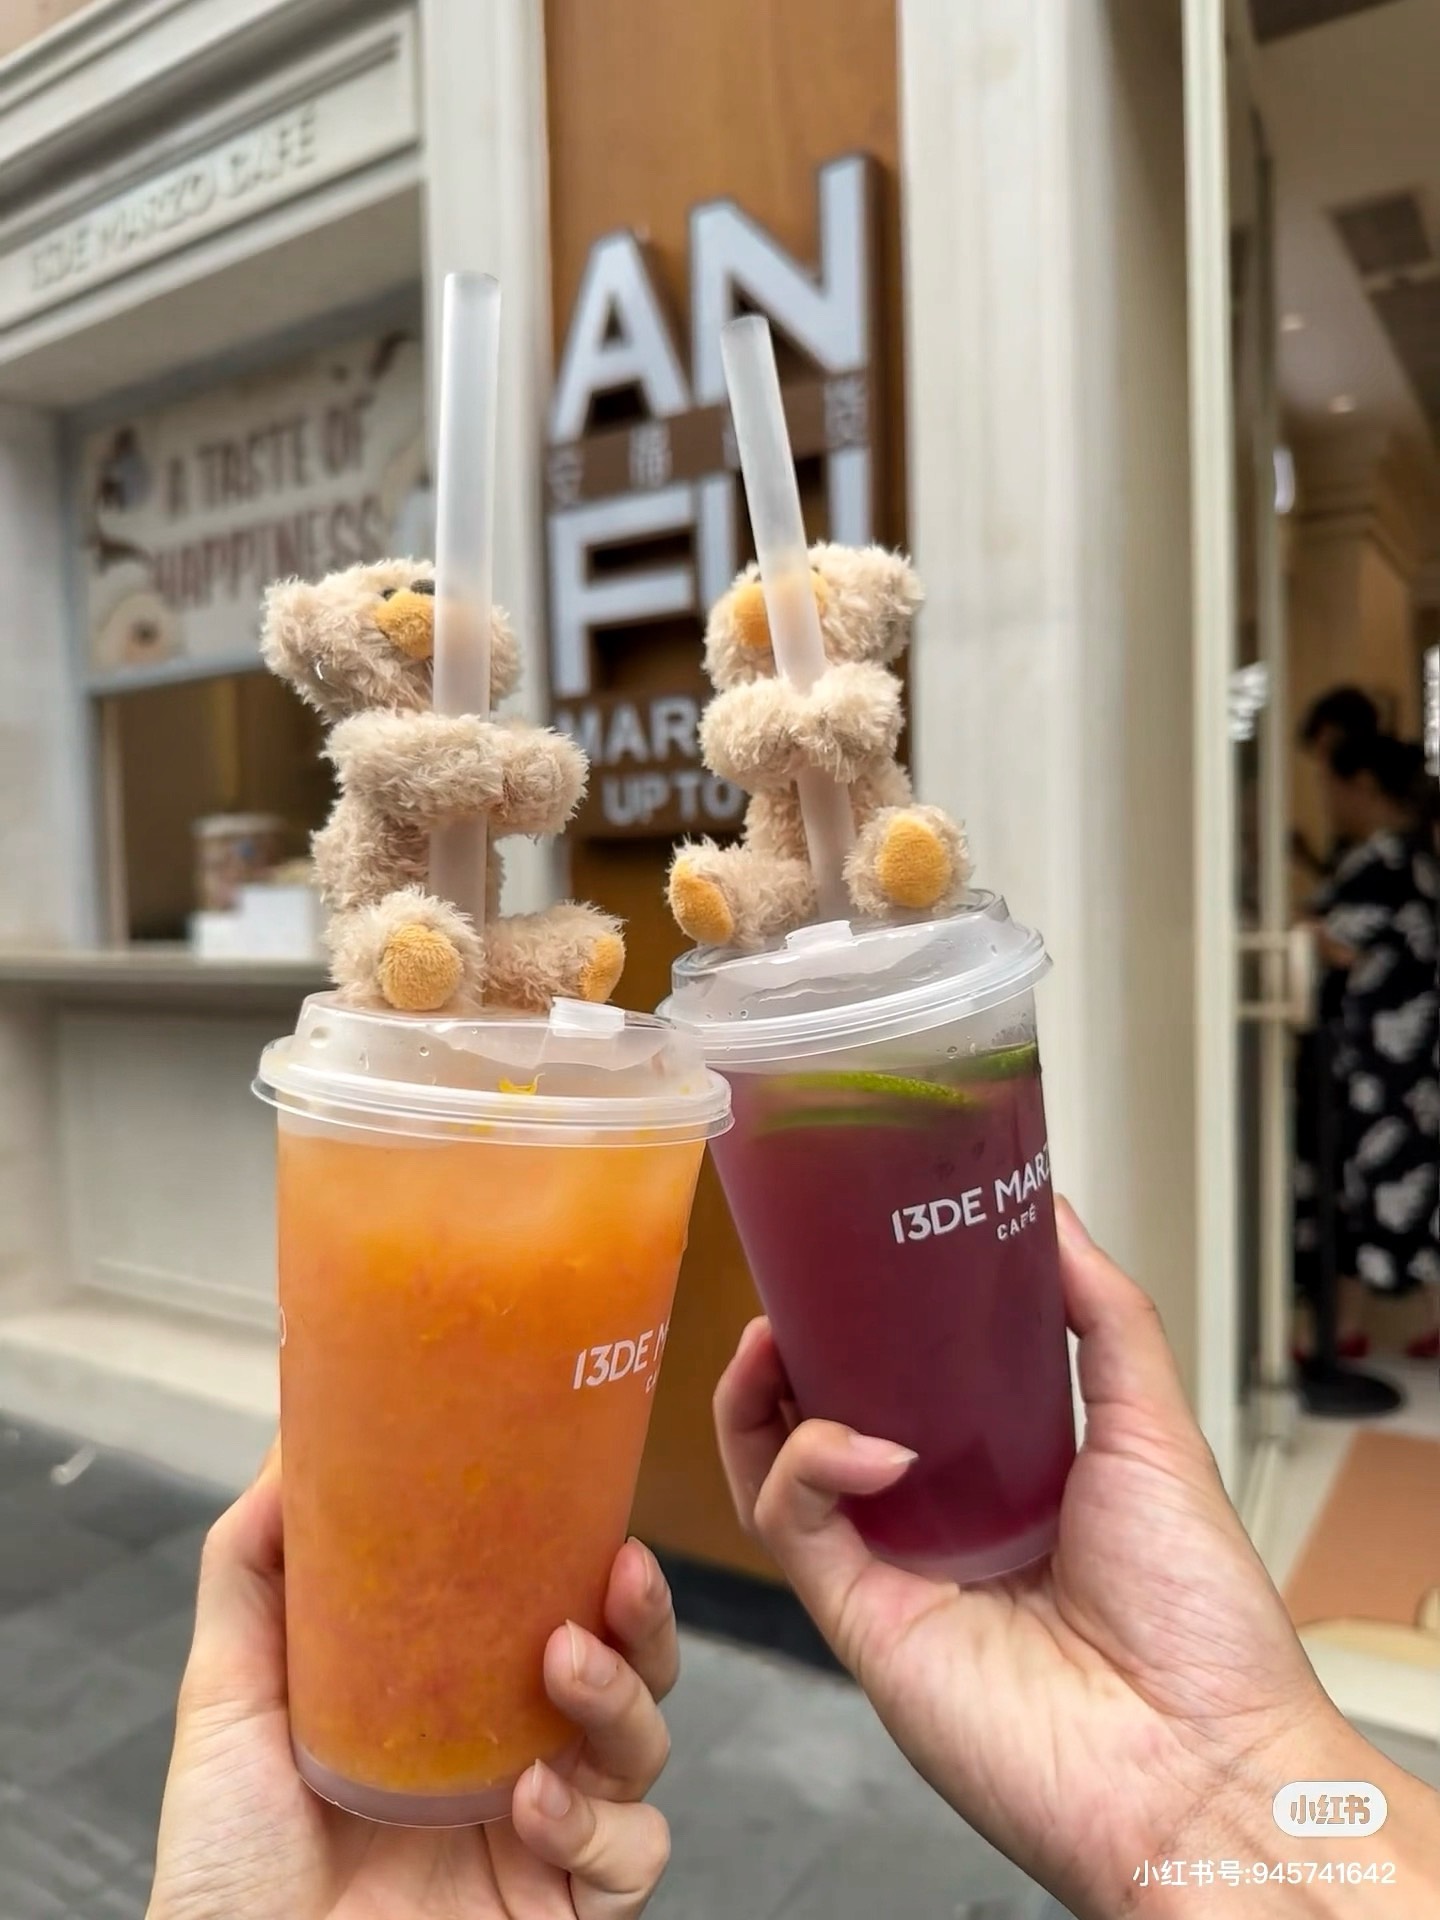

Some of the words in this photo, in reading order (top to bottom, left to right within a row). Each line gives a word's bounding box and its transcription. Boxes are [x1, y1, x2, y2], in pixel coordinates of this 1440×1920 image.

[552, 153, 870, 445] AN
[556, 697, 700, 767] MAR
[891, 1186, 987, 1244] 13DE
[996, 1203, 1037, 1241] CAFÉ
[573, 1329, 654, 1390] 13DE
